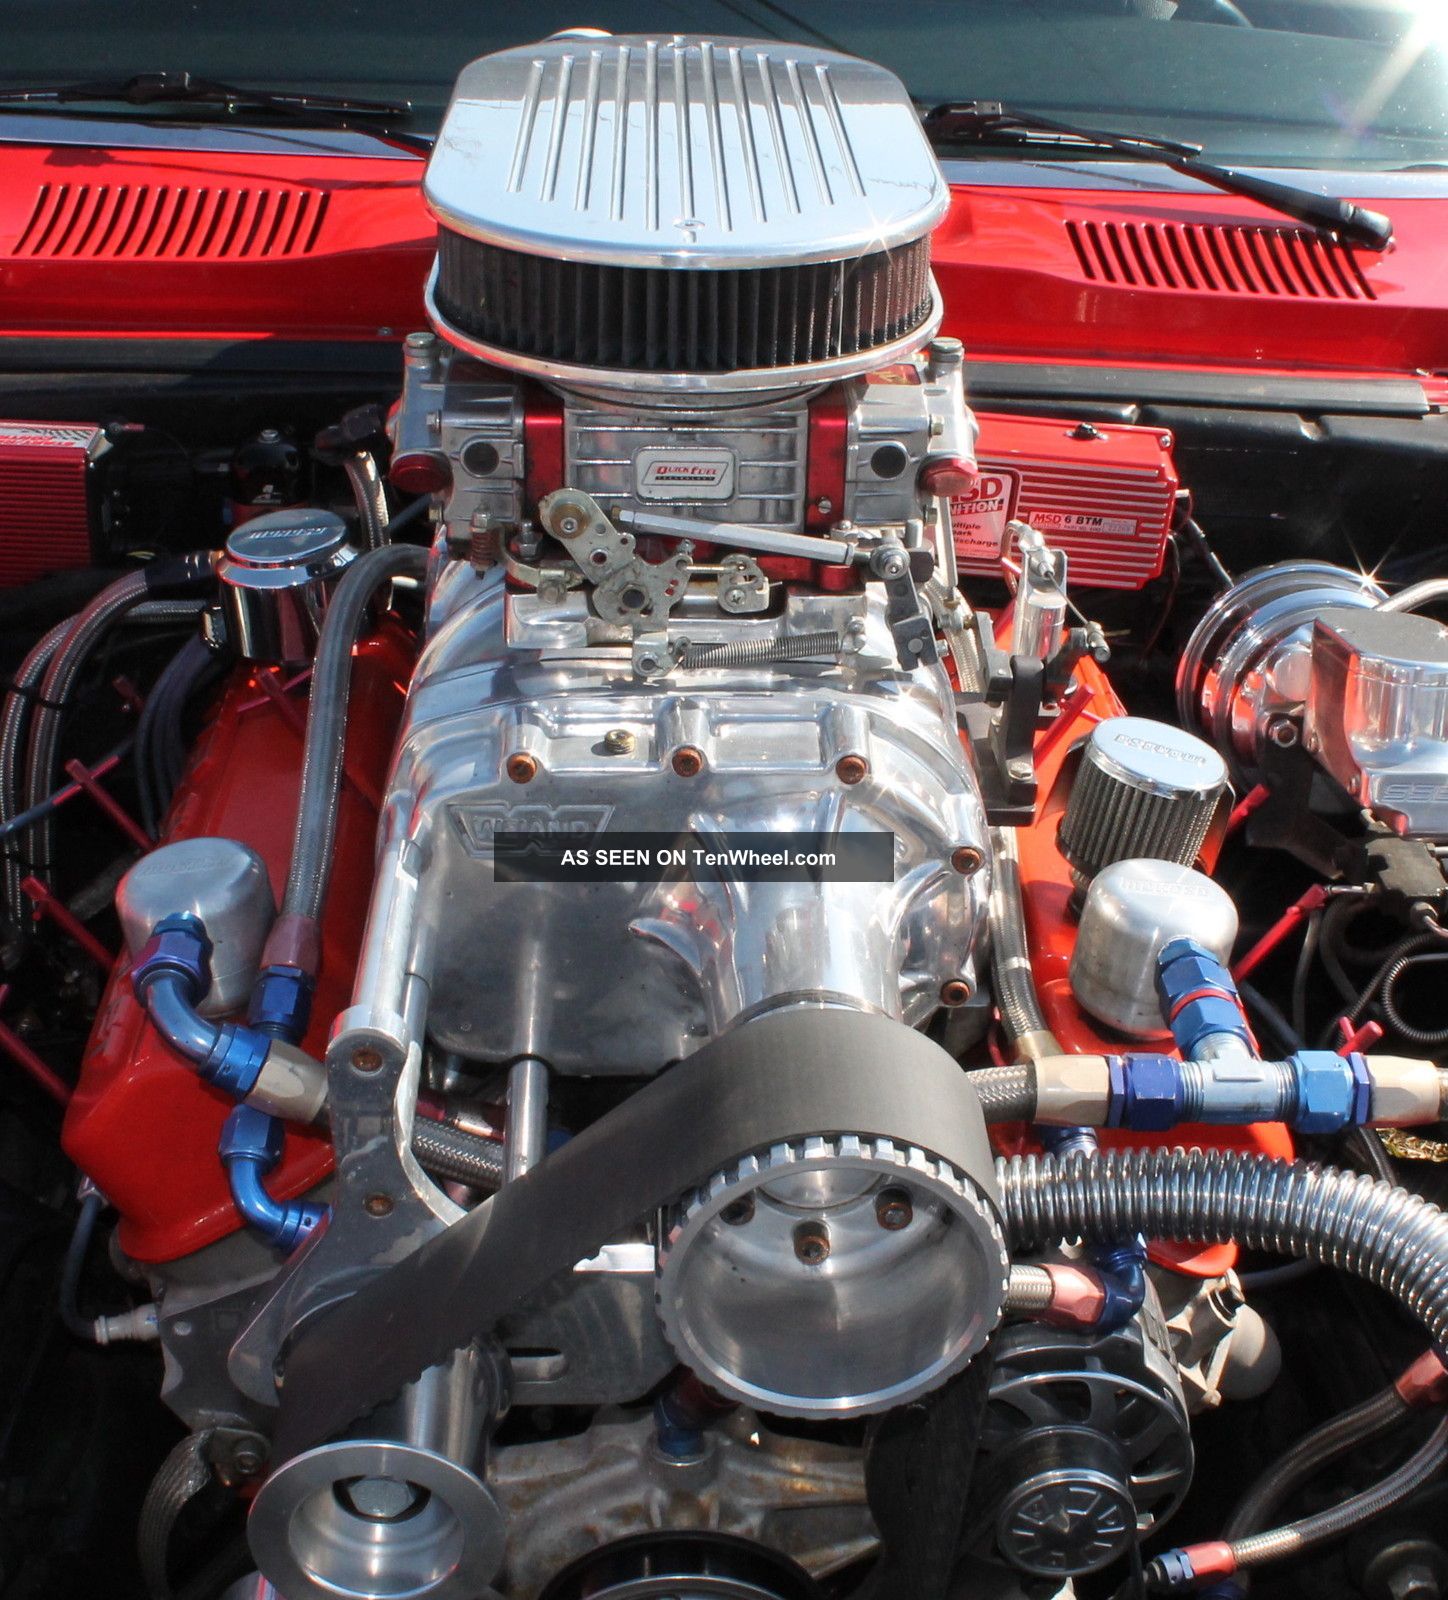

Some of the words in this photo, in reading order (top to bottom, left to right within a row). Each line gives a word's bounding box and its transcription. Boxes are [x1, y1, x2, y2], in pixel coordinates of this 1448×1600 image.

[1034, 513, 1062, 524] MSD
[1065, 515, 1073, 524] 6
[1076, 516, 1104, 526] BTM
